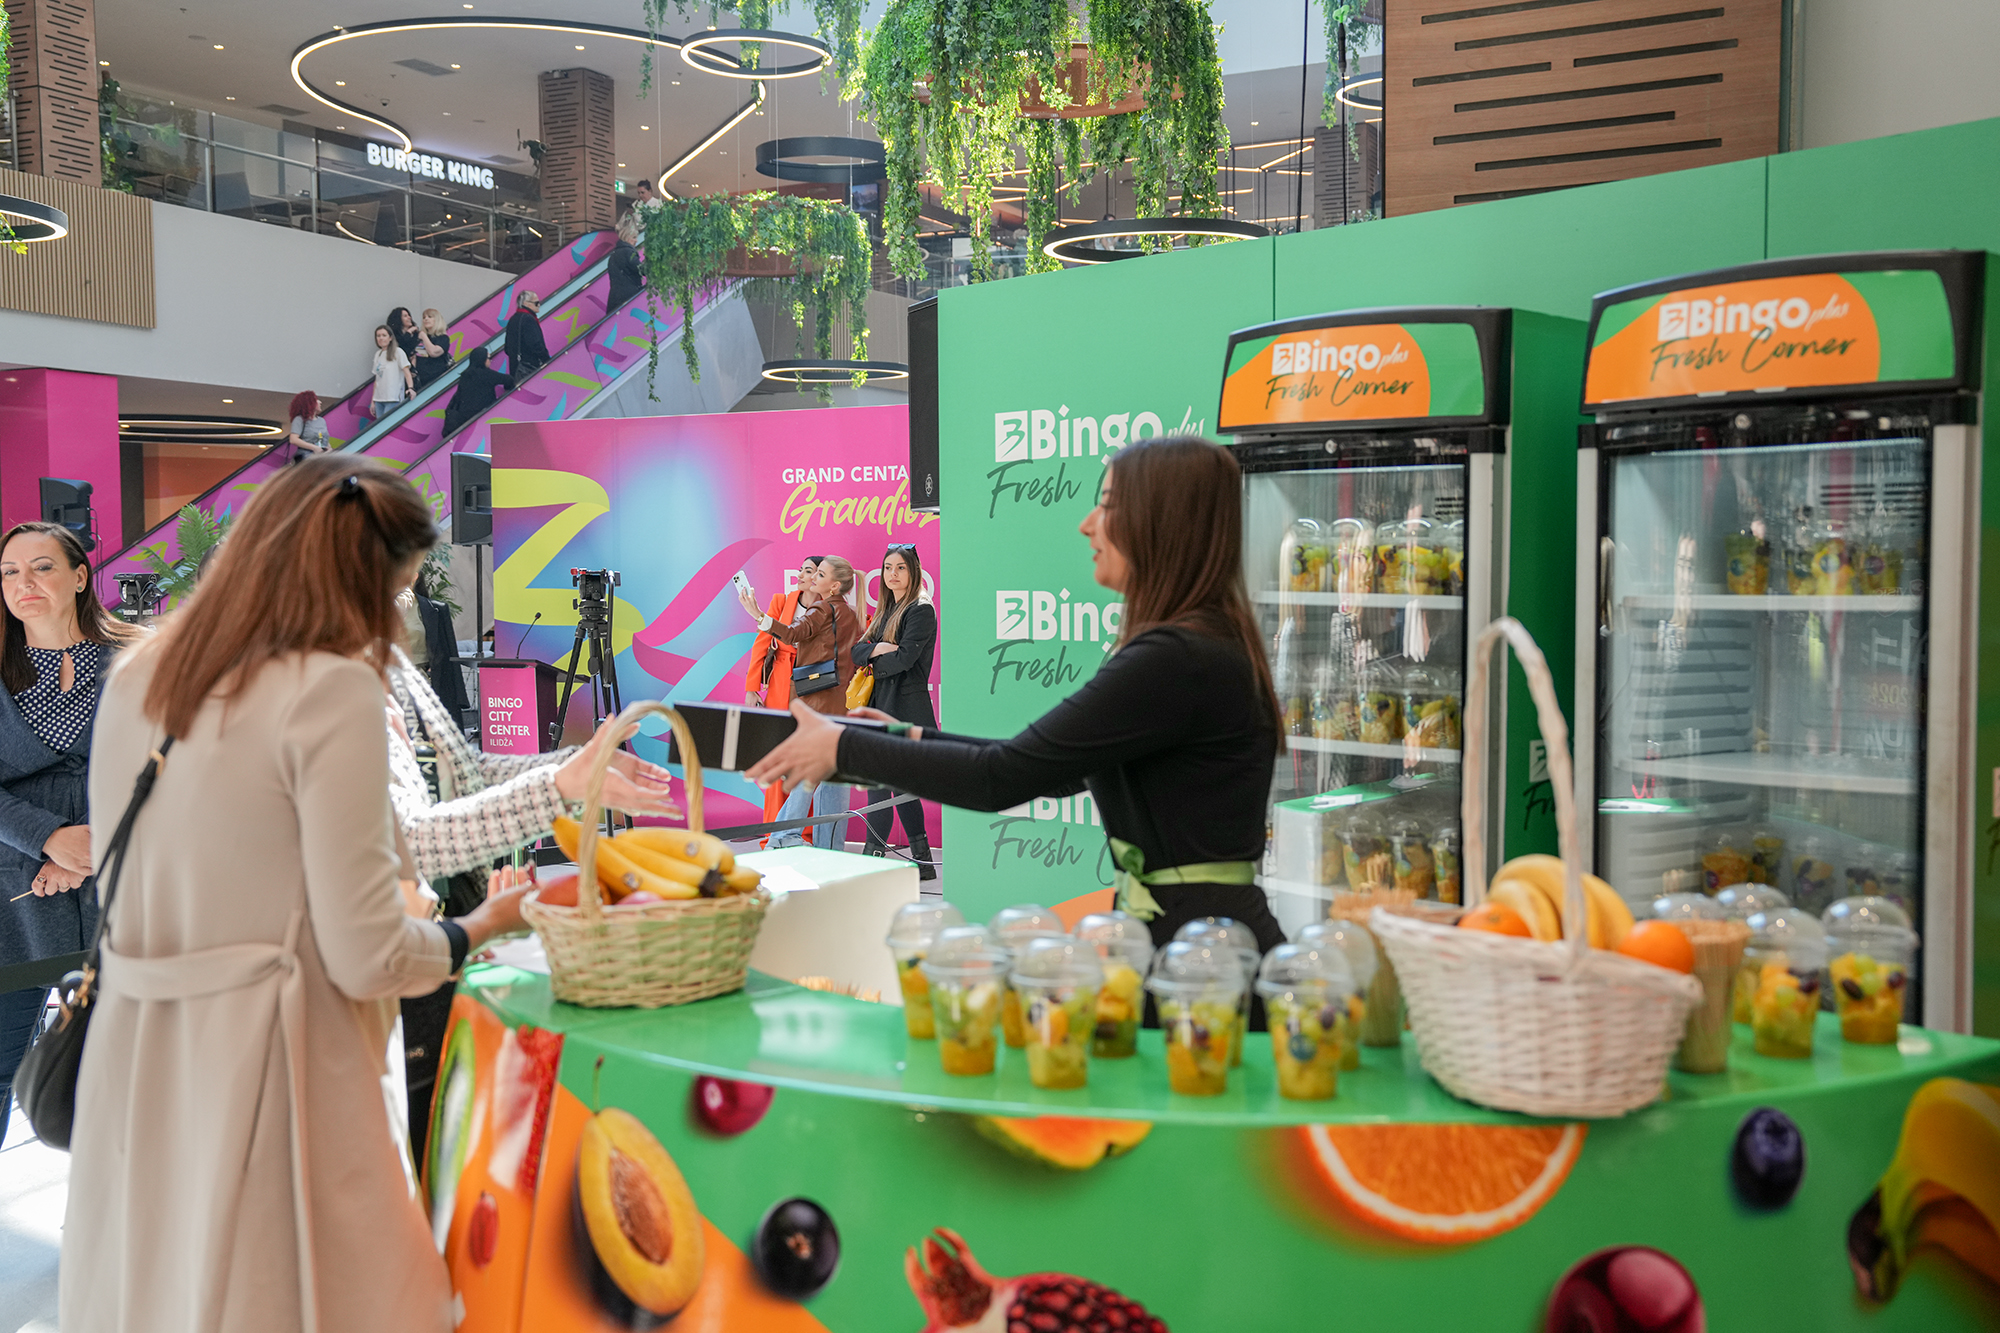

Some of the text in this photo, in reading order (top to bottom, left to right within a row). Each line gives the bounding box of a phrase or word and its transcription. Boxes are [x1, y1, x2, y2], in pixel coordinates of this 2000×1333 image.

[367, 142, 494, 190] BURGER KING
[1689, 293, 1849, 340] Bingo plus
[1294, 339, 1409, 379] Bingo plus
[1650, 326, 1857, 382] Fresh Corner
[1265, 367, 1414, 410] Fresh Corner
[1031, 404, 1163, 465] Bingo
[782, 465, 909, 484] GRAND CENTA
[986, 459, 1082, 519] Fresh
[1032, 587, 1126, 656] Bing
[988, 639, 1083, 695] Fresh
[488, 697, 523, 708] BINGO
[488, 711, 513, 722] CITY
[489, 724, 531, 736] CENTER
[490, 737, 514, 747] ILIDŽA
[989, 816, 1084, 869] Fresh
